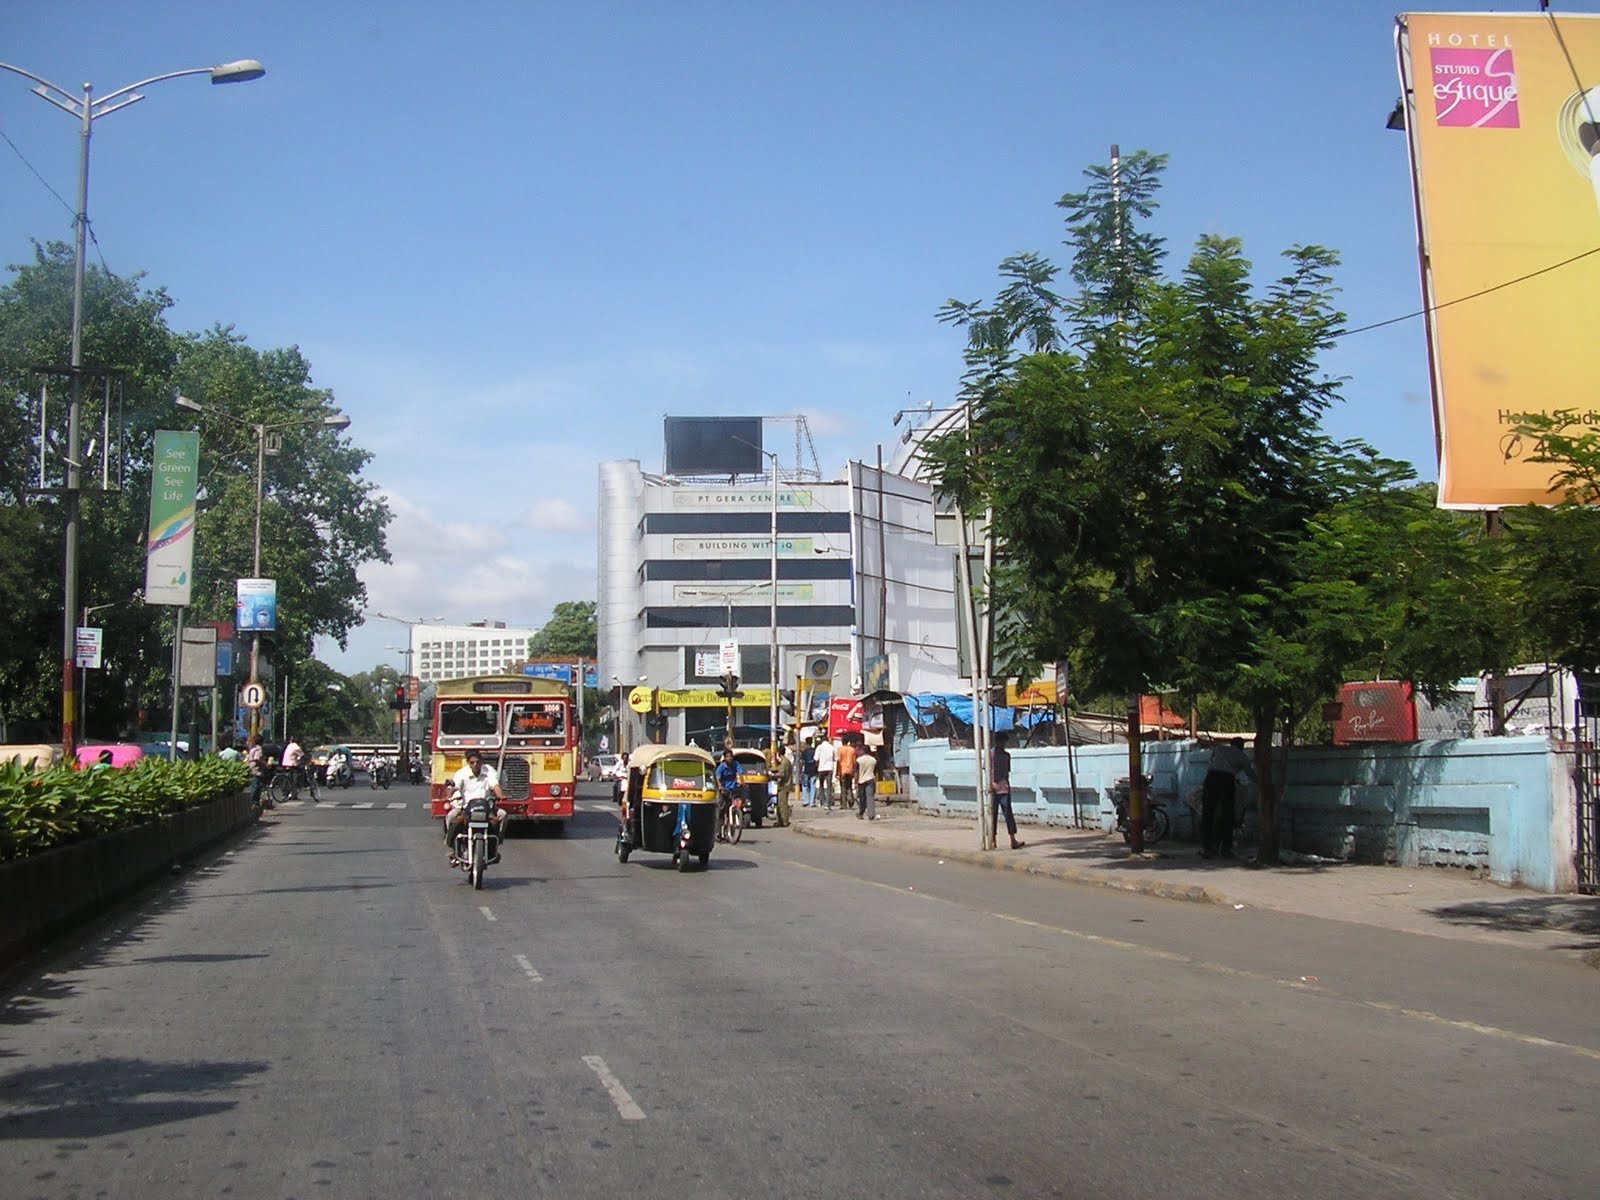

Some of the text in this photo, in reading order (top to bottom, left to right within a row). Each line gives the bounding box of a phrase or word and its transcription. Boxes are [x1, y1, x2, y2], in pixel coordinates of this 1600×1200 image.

[1427, 32, 1512, 48] HOTEL
[1434, 64, 1480, 75] STUDIO
[1498, 409, 1546, 424] Hotl
[166, 448, 186, 459] See
[159, 462, 191, 473] Green
[164, 476, 184, 487] See
[163, 490, 184, 501] Life
